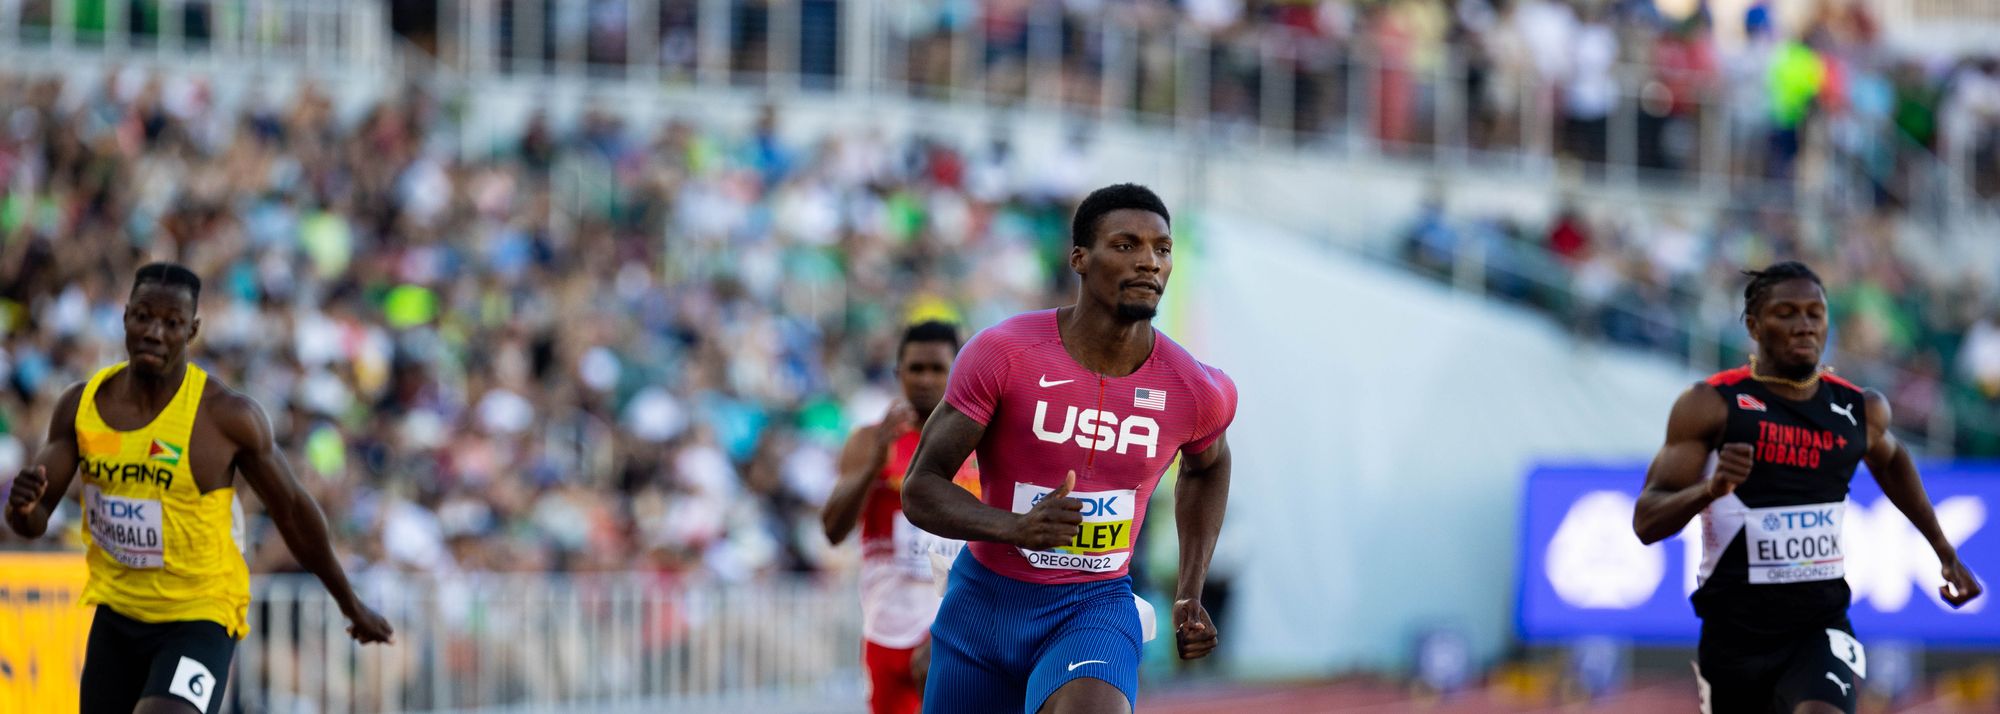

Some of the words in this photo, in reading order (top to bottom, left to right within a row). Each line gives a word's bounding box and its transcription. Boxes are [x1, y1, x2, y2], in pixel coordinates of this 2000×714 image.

[1032, 400, 1160, 458] USA
[1756, 440, 1819, 468] TOBAGO
[1081, 496, 1118, 516] DK
[1781, 508, 1834, 529] TDK
[1067, 524, 1123, 549] LEY
[1757, 534, 1841, 561] ELCOCK
[1028, 552, 1111, 570] OREGON22
[188, 673, 205, 697] 6
